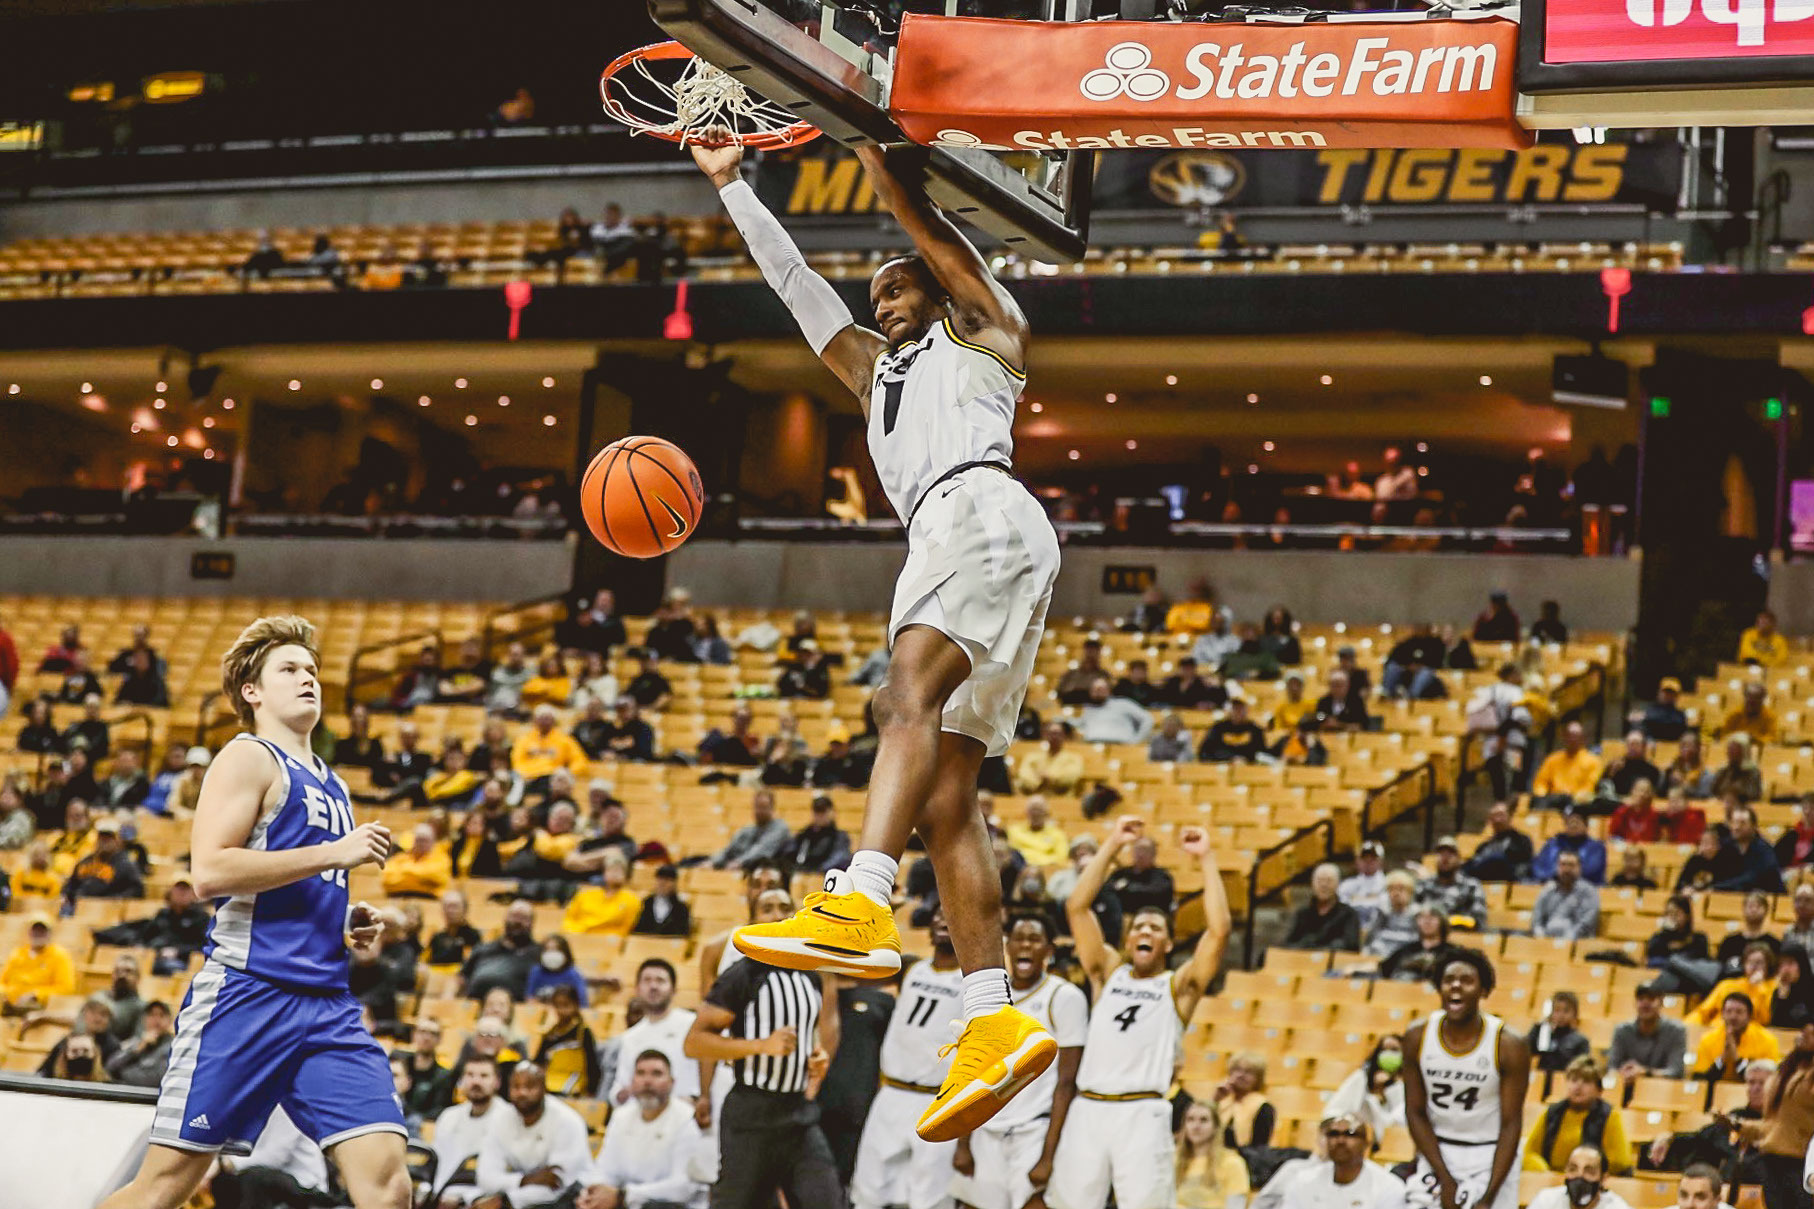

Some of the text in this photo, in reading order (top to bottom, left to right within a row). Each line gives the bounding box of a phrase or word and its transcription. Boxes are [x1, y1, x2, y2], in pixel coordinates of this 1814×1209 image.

[1316, 145, 1628, 203] TIGERS
[882, 379, 905, 437] 1
[906, 996, 939, 1027] 11
[1113, 1004, 1142, 1032] 4
[1431, 1083, 1480, 1111] 24
